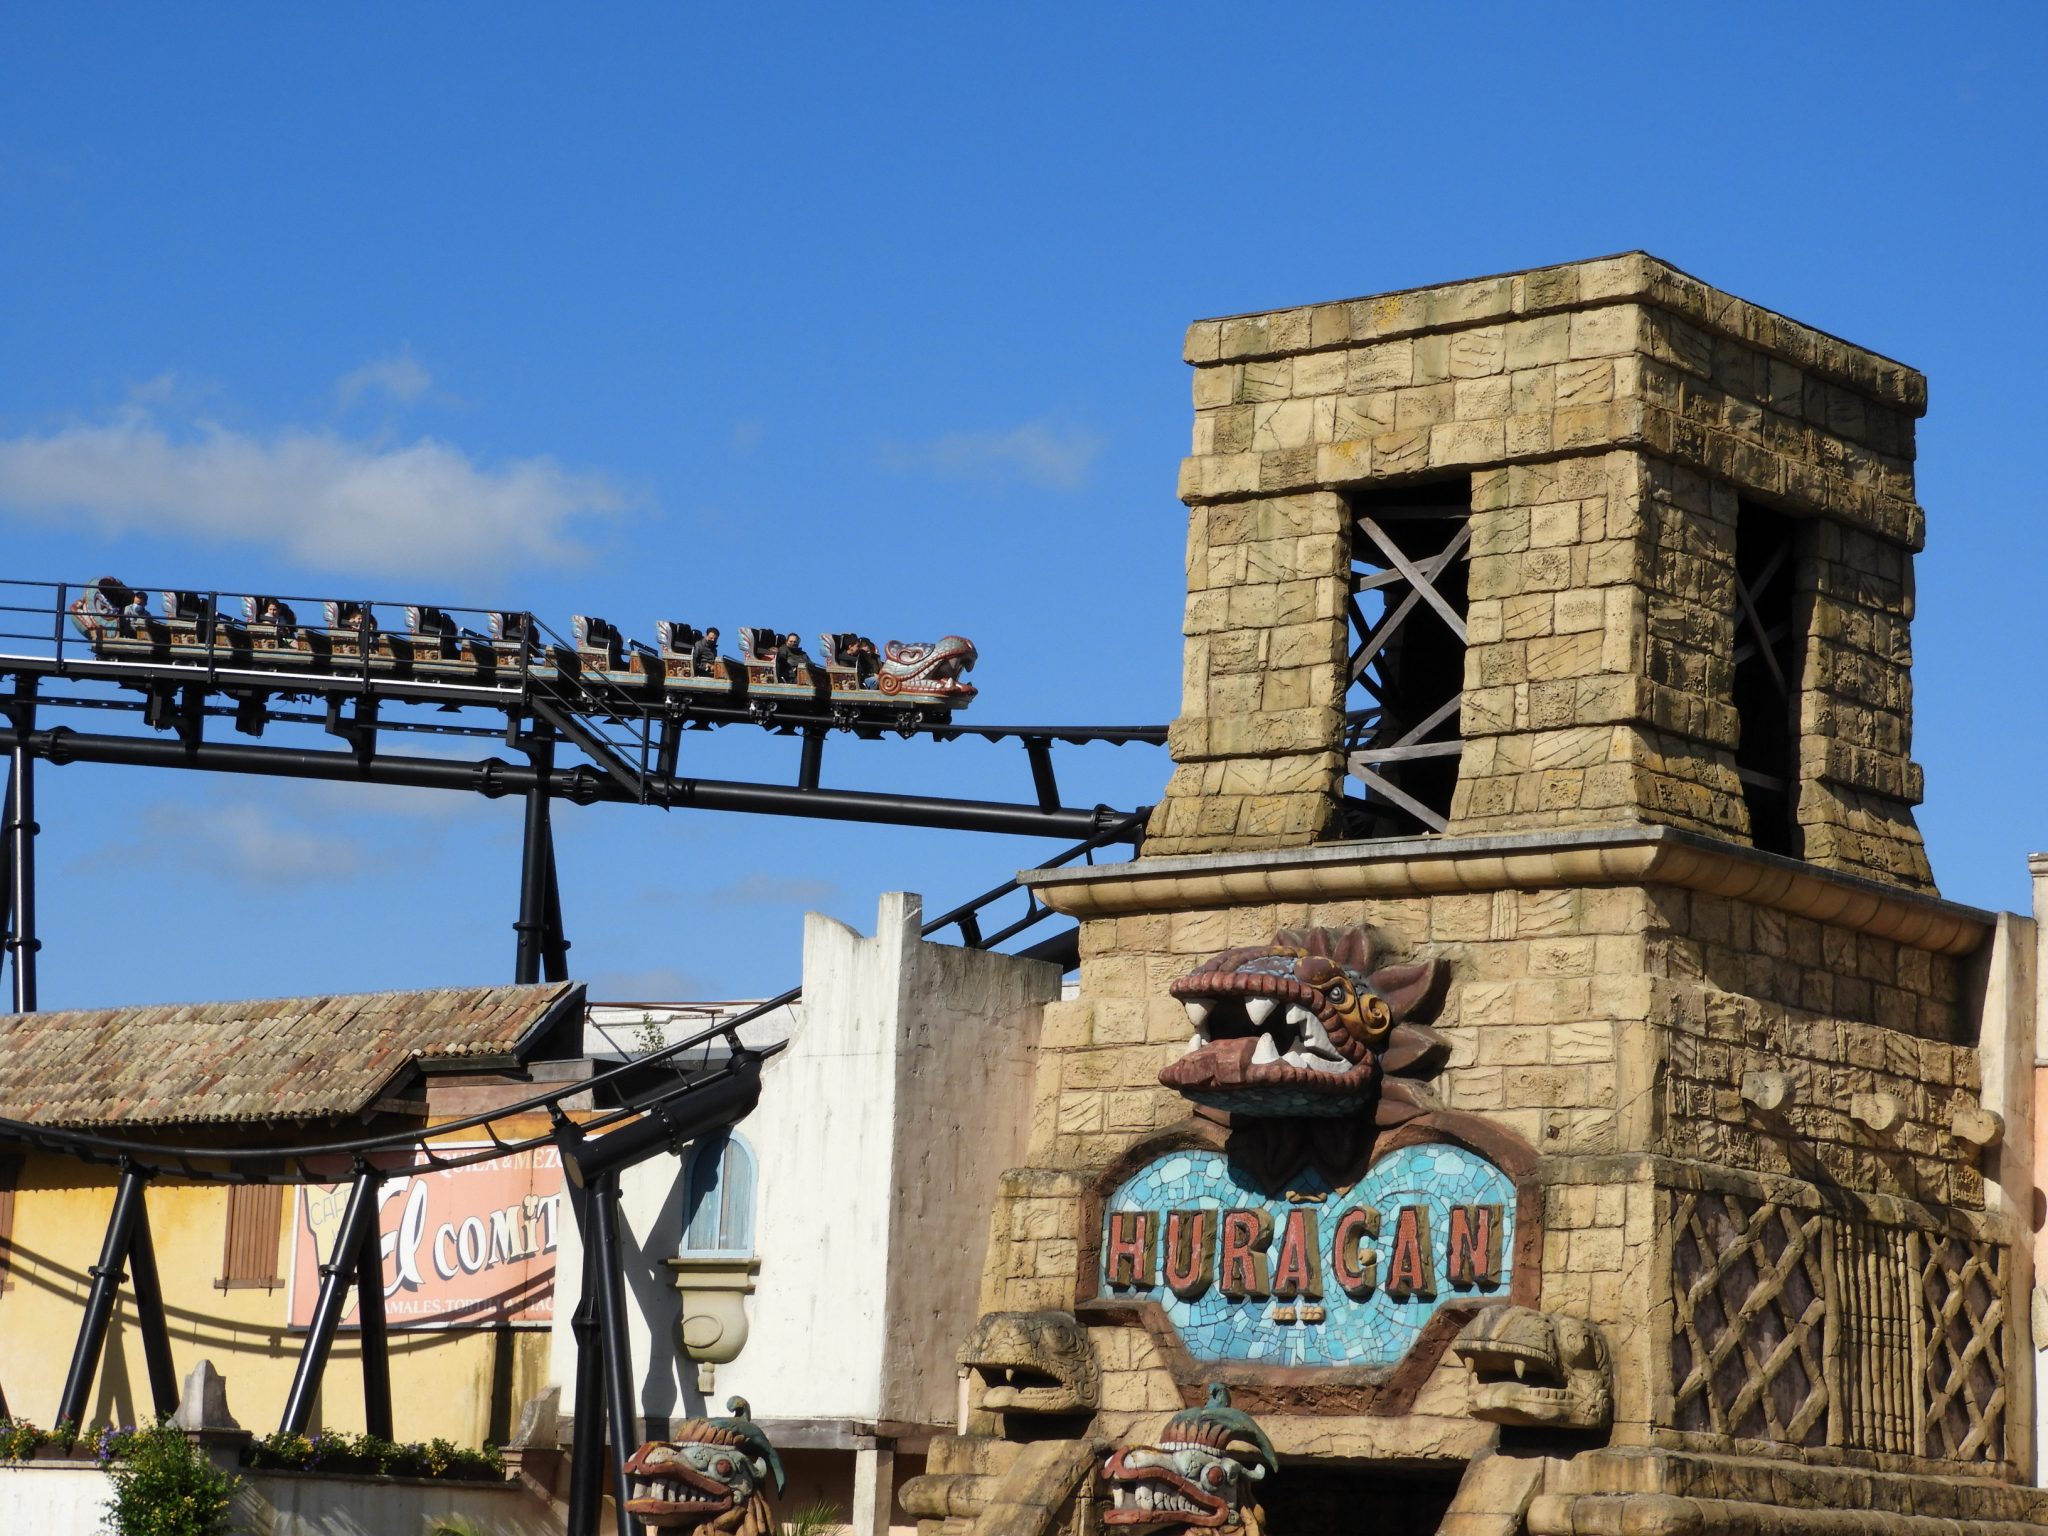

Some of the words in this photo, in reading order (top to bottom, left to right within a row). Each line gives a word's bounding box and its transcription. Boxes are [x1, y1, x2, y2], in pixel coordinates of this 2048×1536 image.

[409, 1150, 499, 1179] TQUILA
[378, 1176, 426, 1298] El
[1105, 1204, 1501, 1301] HURACAN
